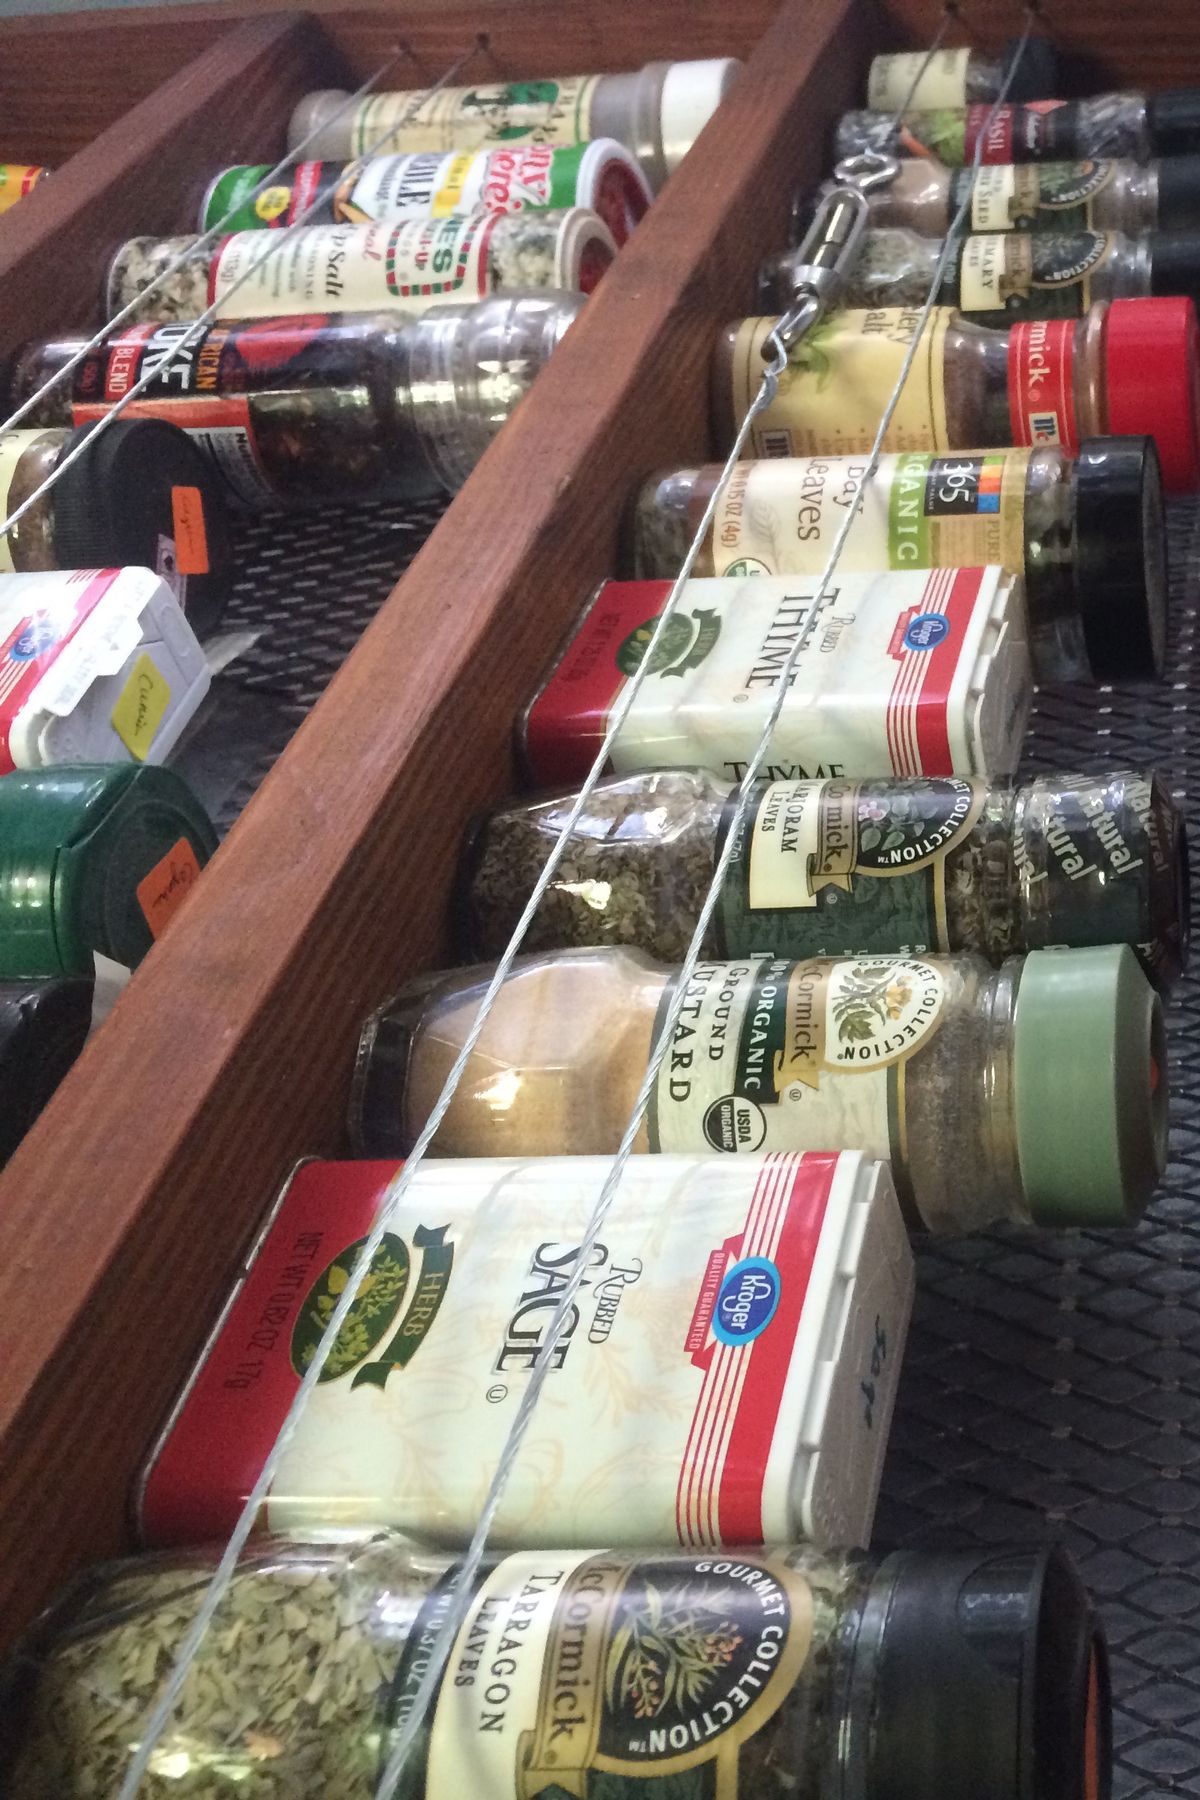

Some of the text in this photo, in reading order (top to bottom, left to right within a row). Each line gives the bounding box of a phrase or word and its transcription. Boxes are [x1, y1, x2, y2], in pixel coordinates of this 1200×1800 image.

[862, 312, 888, 335] alt
[1028, 320, 1050, 385] rmick
[108, 347, 137, 393] BLEND
[939, 461, 976, 504] 365
[720, 520, 741, 549] (4g)
[744, 587, 842, 689] THYME
[761, 790, 791, 833] LEAVES
[889, 795, 971, 864] COLLECTION
[857, 959, 937, 982] GOURMET
[708, 967, 750, 1061] GROUND
[743, 985, 778, 1090] ORGANIC
[841, 987, 939, 1061] COLLECTION
[720, 1104, 734, 1148] ORGANIC
[736, 1109, 752, 1144] USDA
[400, 1272, 447, 1338] HERB
[495, 1241, 610, 1374] SAGE
[587, 1257, 644, 1345] RUBBED
[688, 1252, 726, 1350] QUALITY GUARANTEED
[722, 1274, 772, 1330] Kroger
[454, 1596, 511, 1688] LEAVES
[478, 1570, 566, 1735] TARRAGON
[647, 1560, 787, 1753] GOURMET COLLECTION
